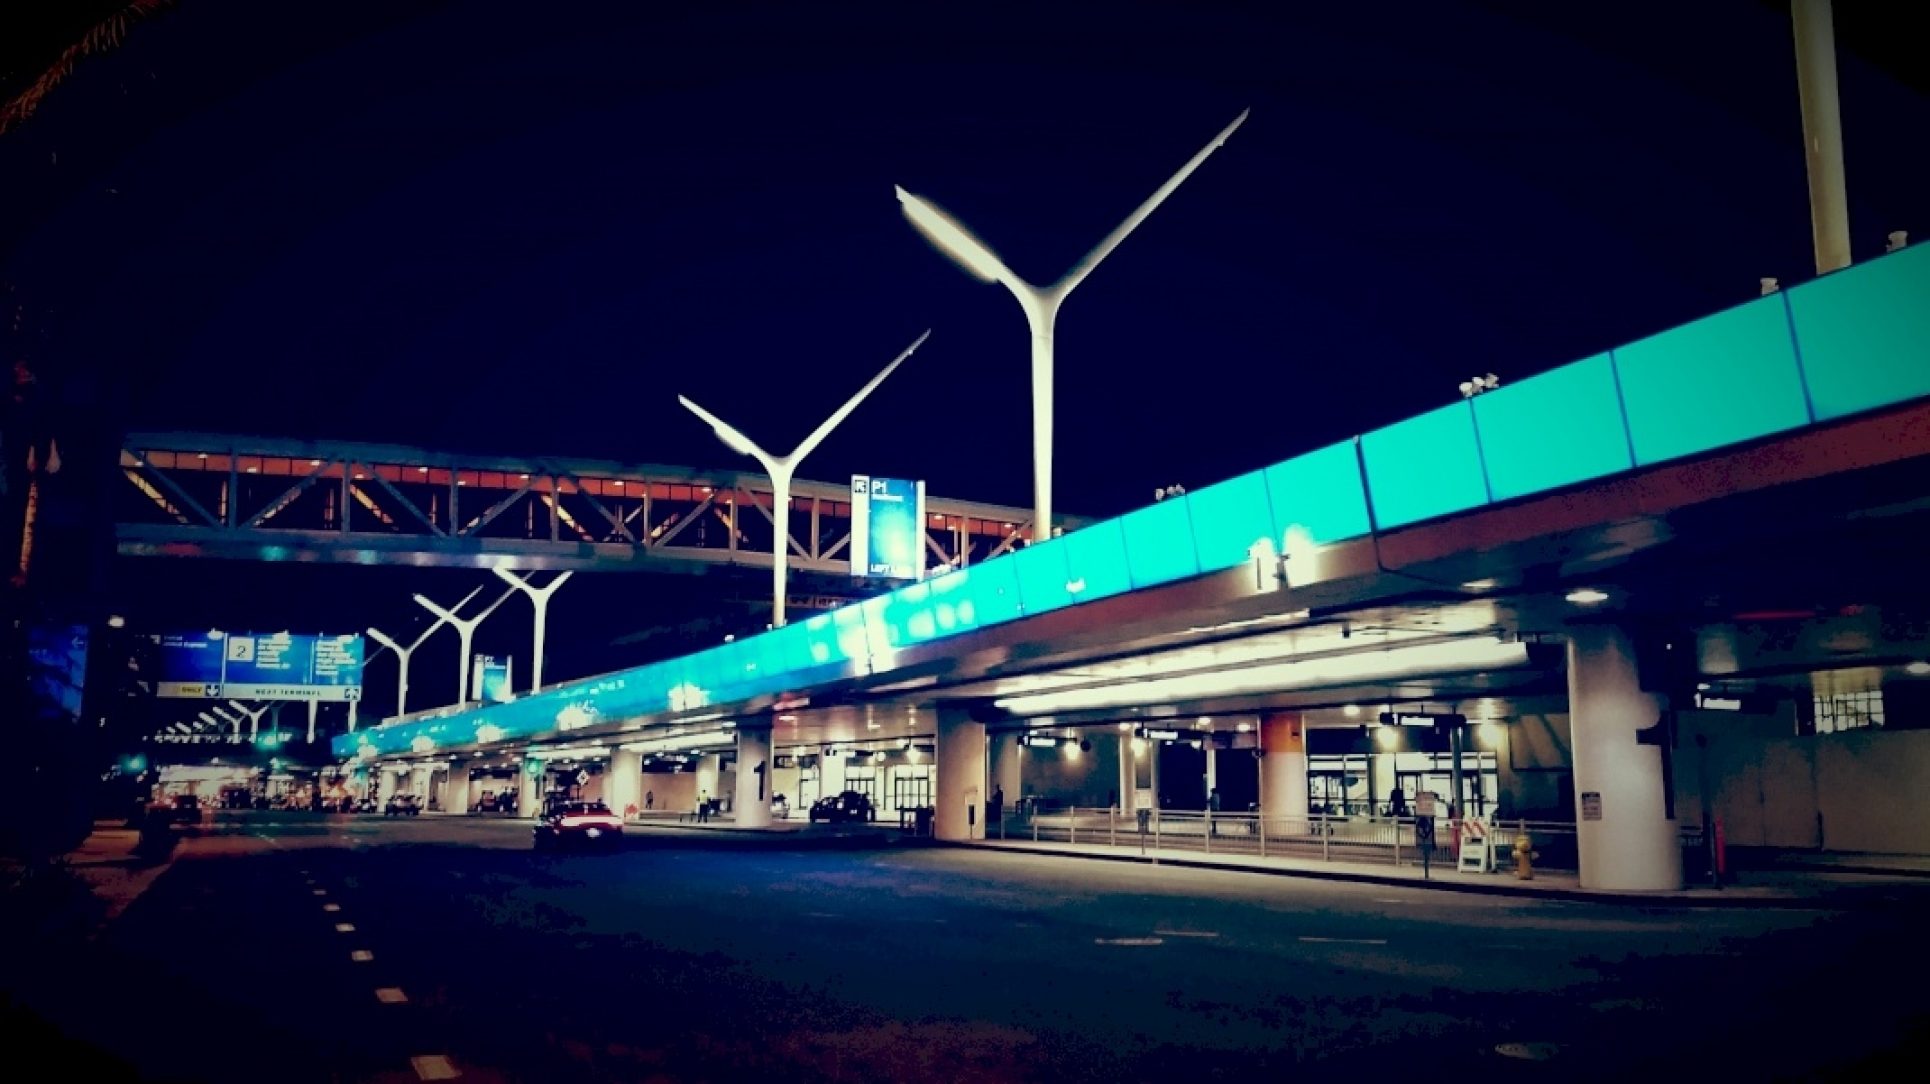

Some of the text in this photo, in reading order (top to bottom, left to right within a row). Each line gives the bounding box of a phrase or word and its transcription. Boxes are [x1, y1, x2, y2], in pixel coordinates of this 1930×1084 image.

[236, 644, 247, 658] 2
[753, 761, 765, 801] 1
[1636, 711, 1675, 820] 1
